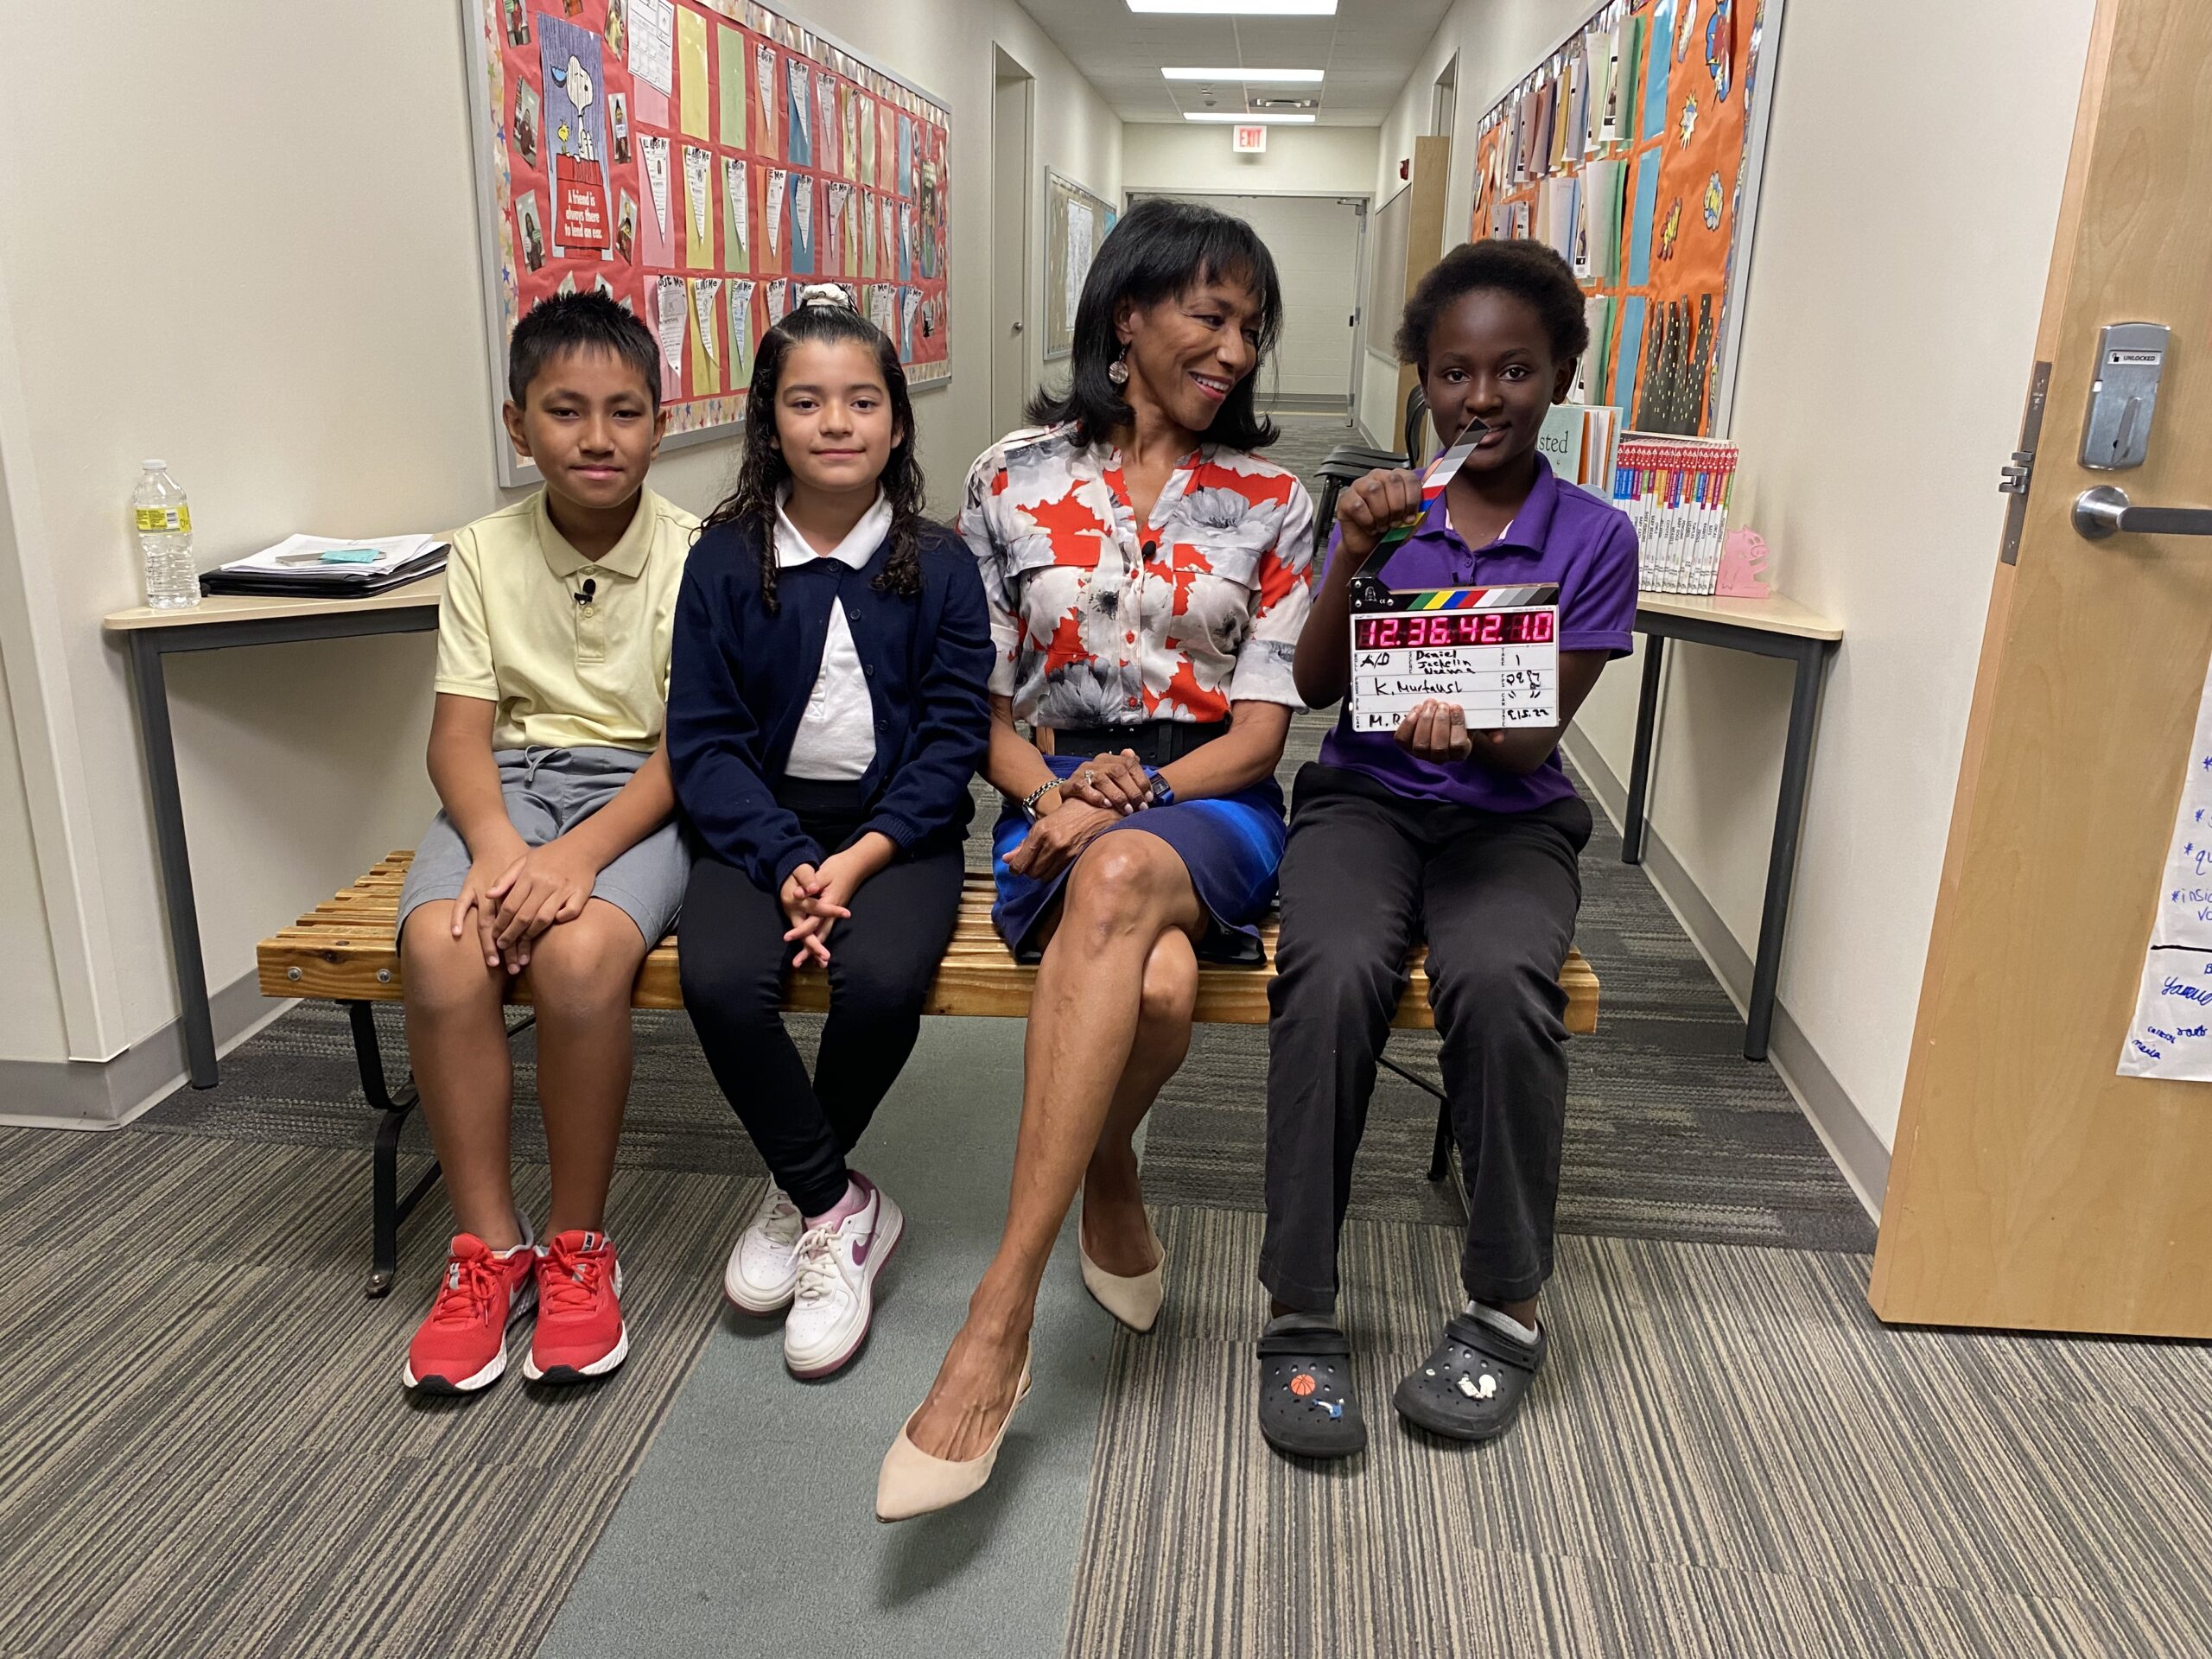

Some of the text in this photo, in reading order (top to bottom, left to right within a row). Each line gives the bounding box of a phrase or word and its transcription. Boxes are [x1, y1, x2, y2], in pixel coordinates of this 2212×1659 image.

[1239, 129, 1262, 147] EXIT
[568, 188, 595, 207] A friend is
[566, 205, 600, 224] always there
[565, 223, 571, 237] to
[571, 221, 584, 238] lend
[584, 227, 592, 238] an
[1416, 650, 1457, 661] Daniel
